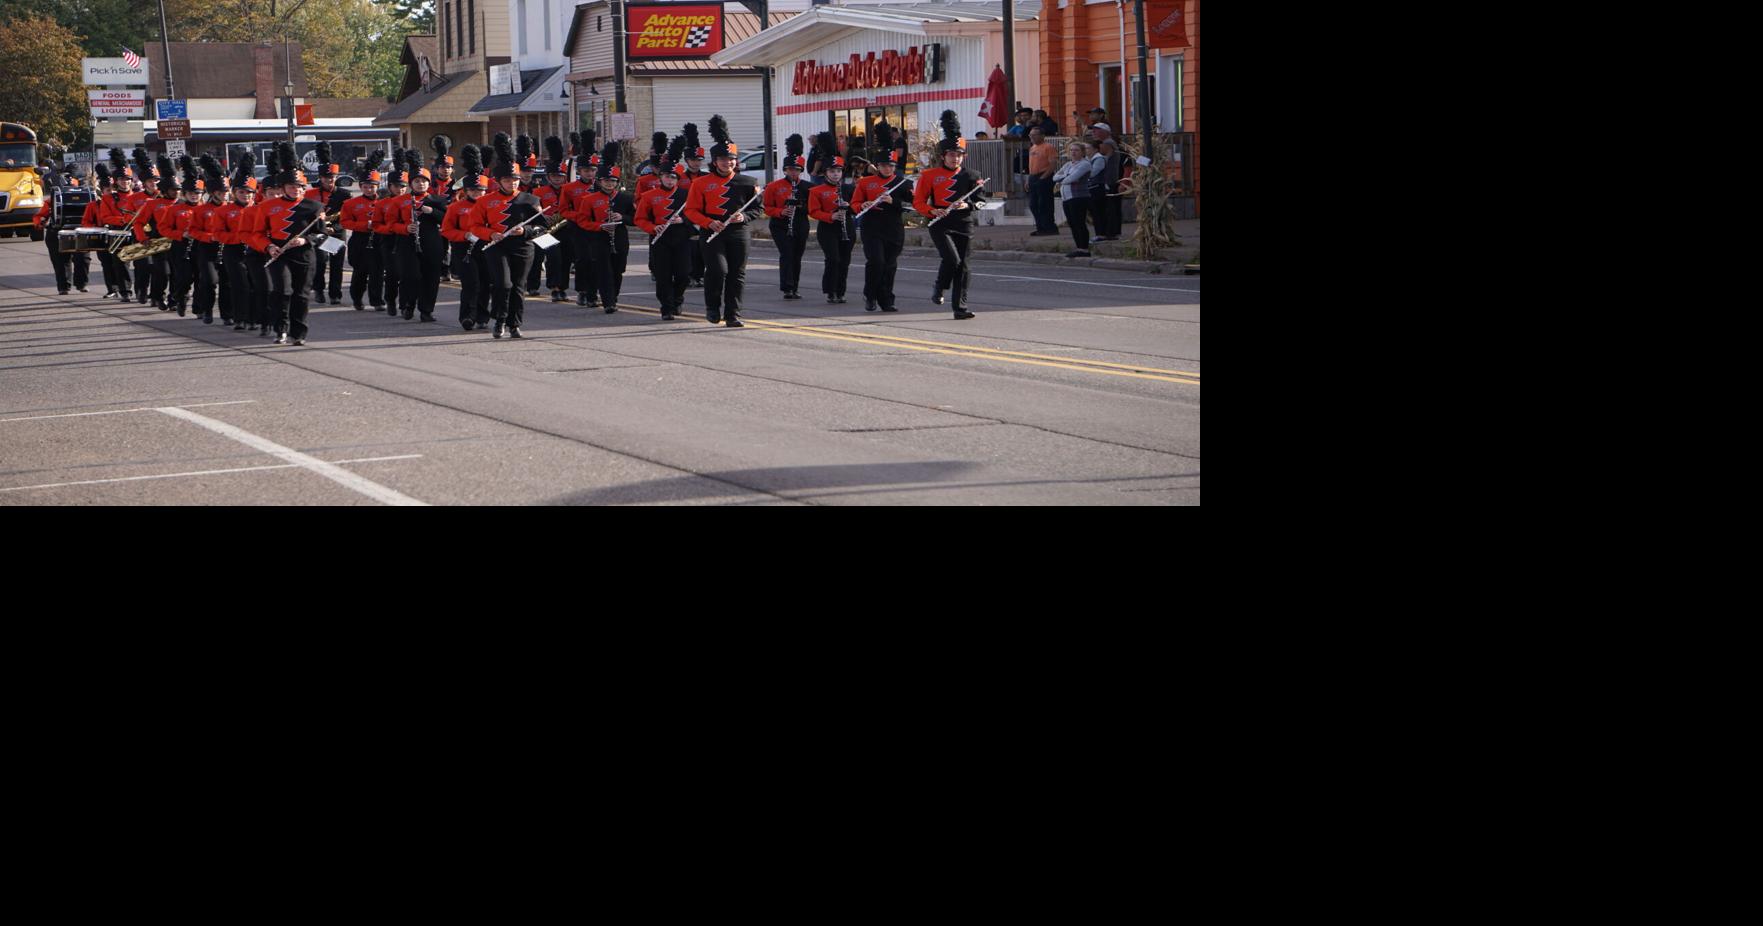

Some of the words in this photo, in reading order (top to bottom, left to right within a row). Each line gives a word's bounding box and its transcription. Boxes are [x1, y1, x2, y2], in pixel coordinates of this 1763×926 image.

[644, 14, 715, 26] Advance
[640, 26, 682, 37] Auto
[636, 38, 678, 48] Parts
[791, 60, 848, 96] Advance
[846, 51, 881, 91] Auto
[881, 46, 924, 88] Parts
[169, 150, 184, 158] 25
